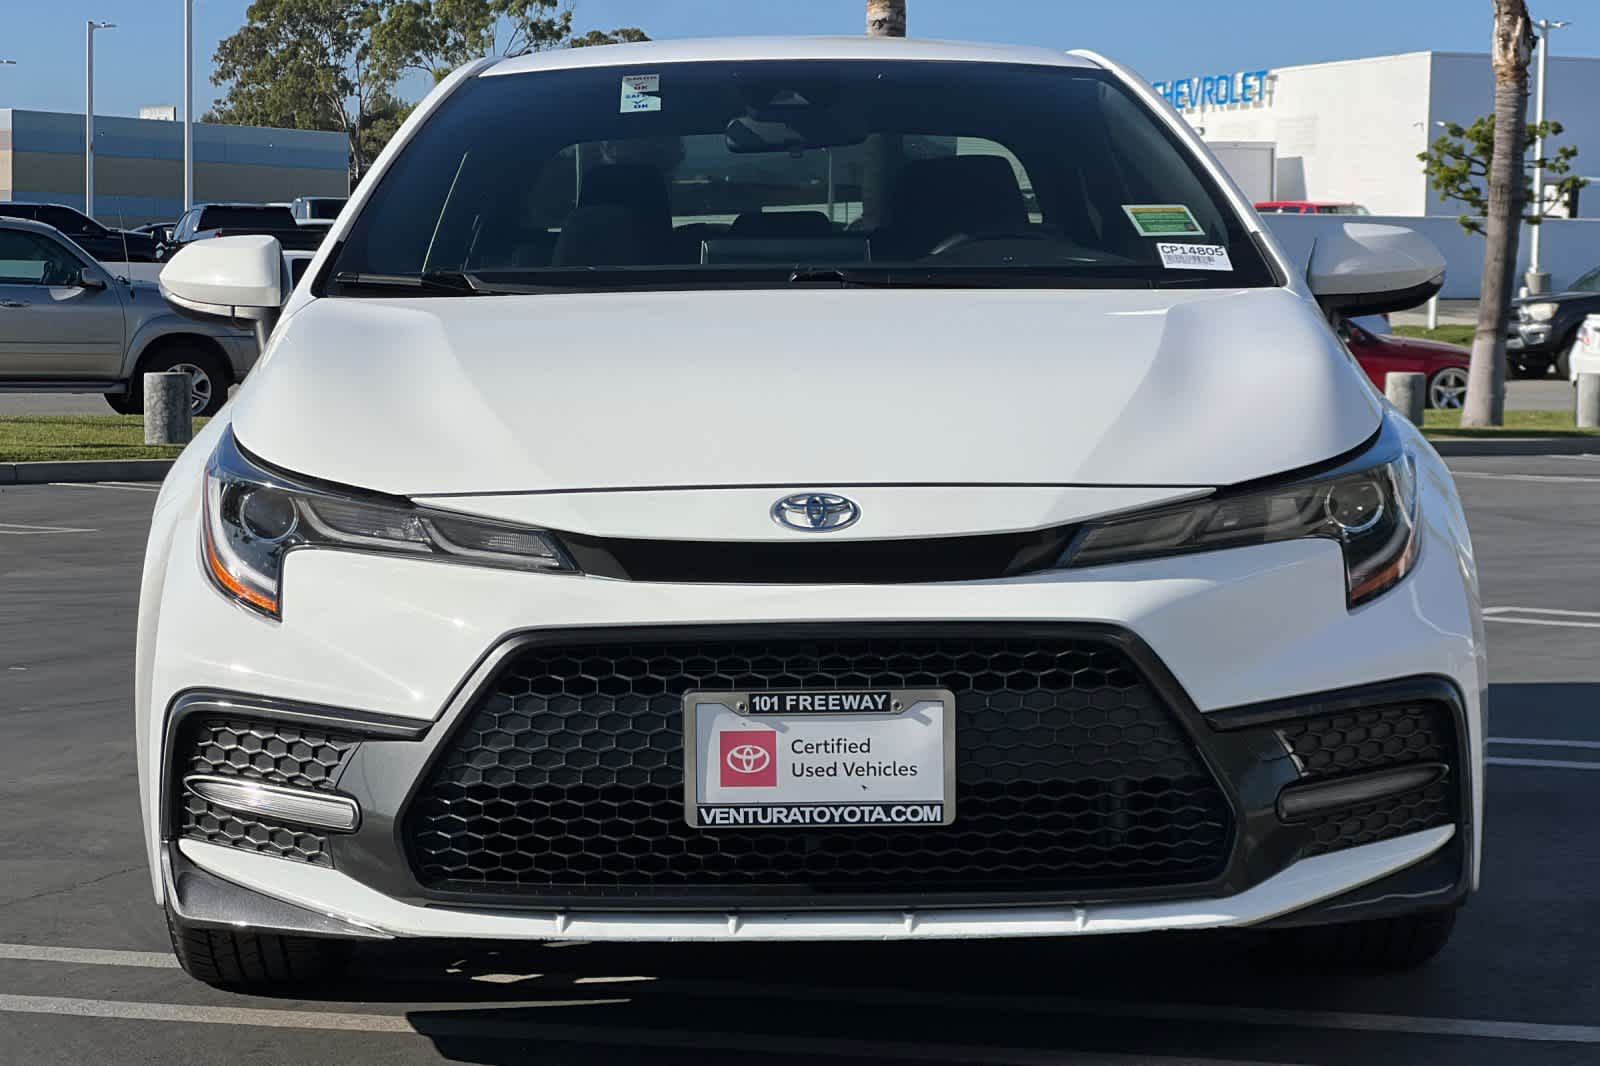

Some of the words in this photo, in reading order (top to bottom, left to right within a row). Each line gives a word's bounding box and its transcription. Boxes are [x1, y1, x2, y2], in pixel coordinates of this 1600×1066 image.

[1161, 245, 1224, 256] CP14805
[752, 695, 779, 711] 101
[786, 694, 887, 711] FREEWAY
[791, 738, 871, 754] Certified
[792, 762, 837, 777] Used
[842, 760, 918, 777] Vehicles
[700, 805, 941, 825] VENTURATOYOTA.COM
